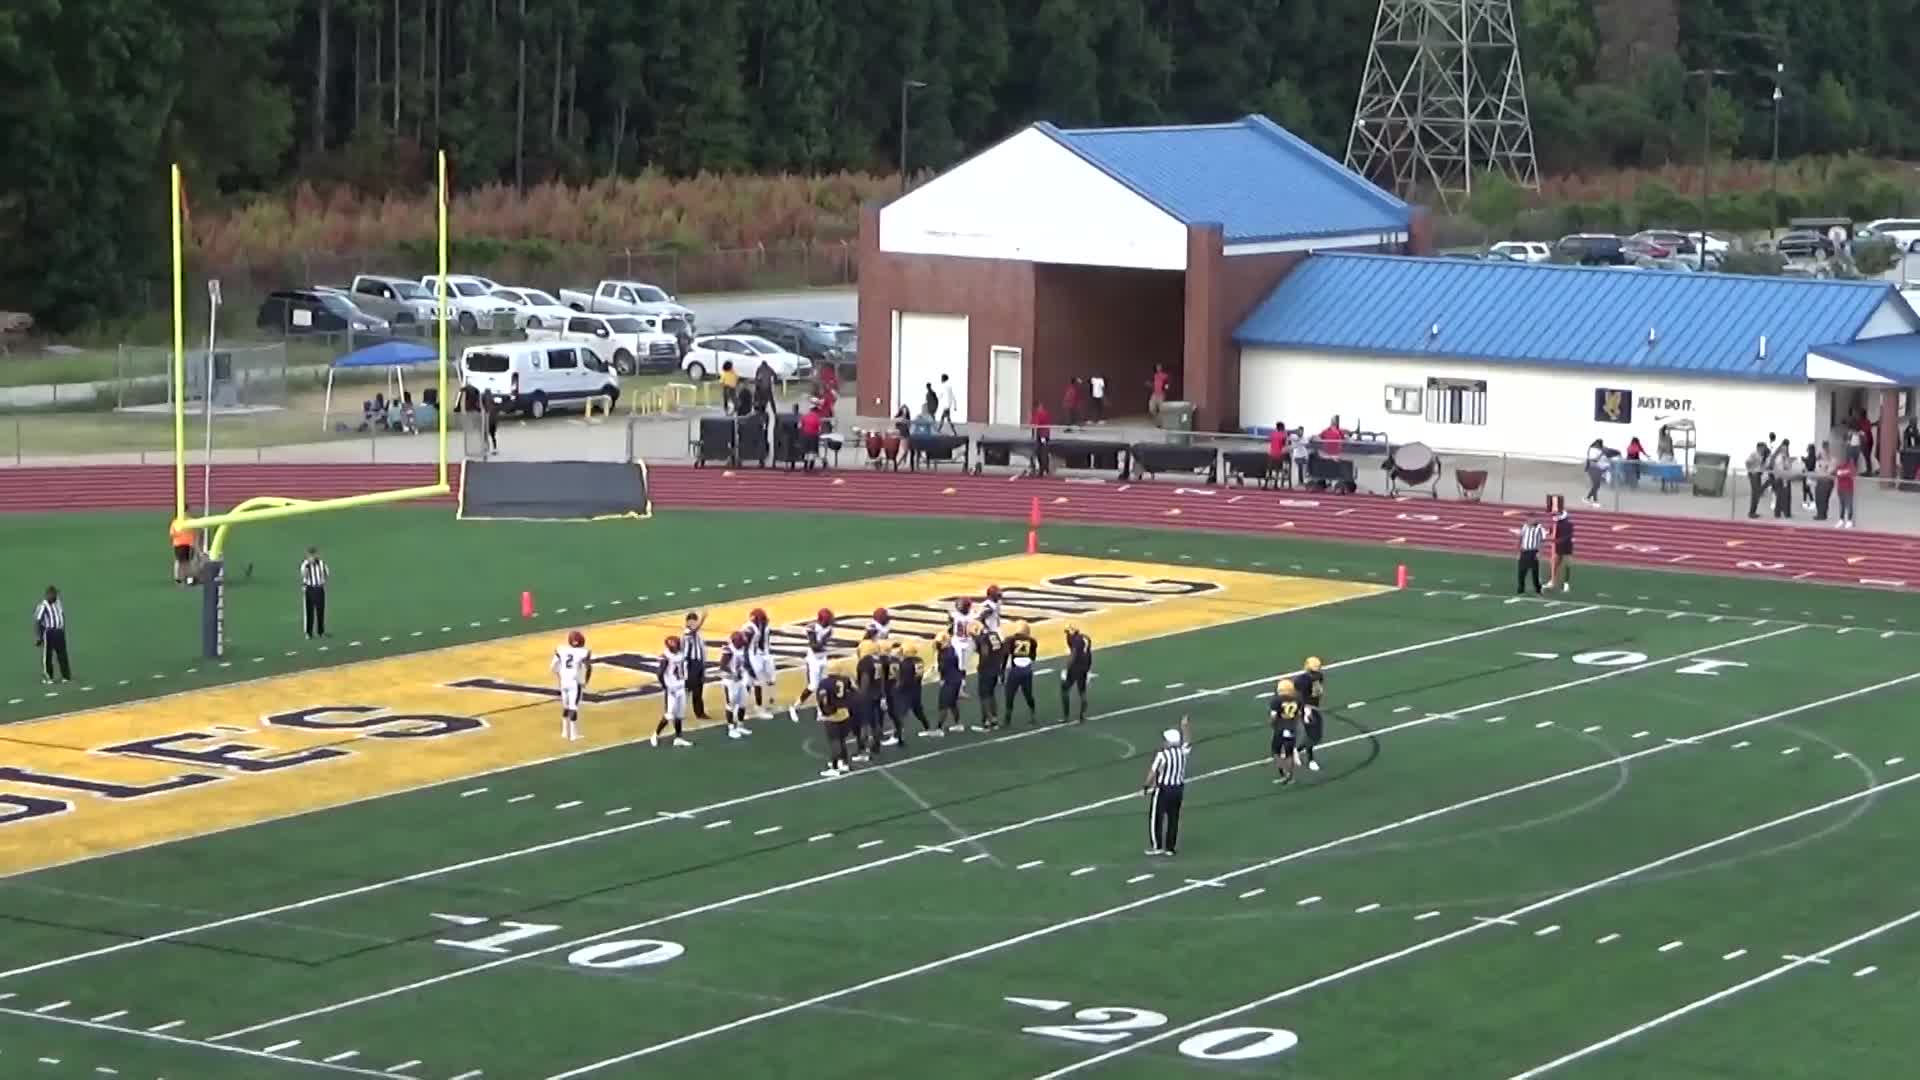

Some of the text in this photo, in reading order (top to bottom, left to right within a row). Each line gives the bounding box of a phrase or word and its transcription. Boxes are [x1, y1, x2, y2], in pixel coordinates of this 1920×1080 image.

[1637, 397, 1661, 409] JUST
[1664, 398, 1680, 410] DO
[565, 653, 575, 669] 2
[1021, 1007, 1299, 1060] 20
